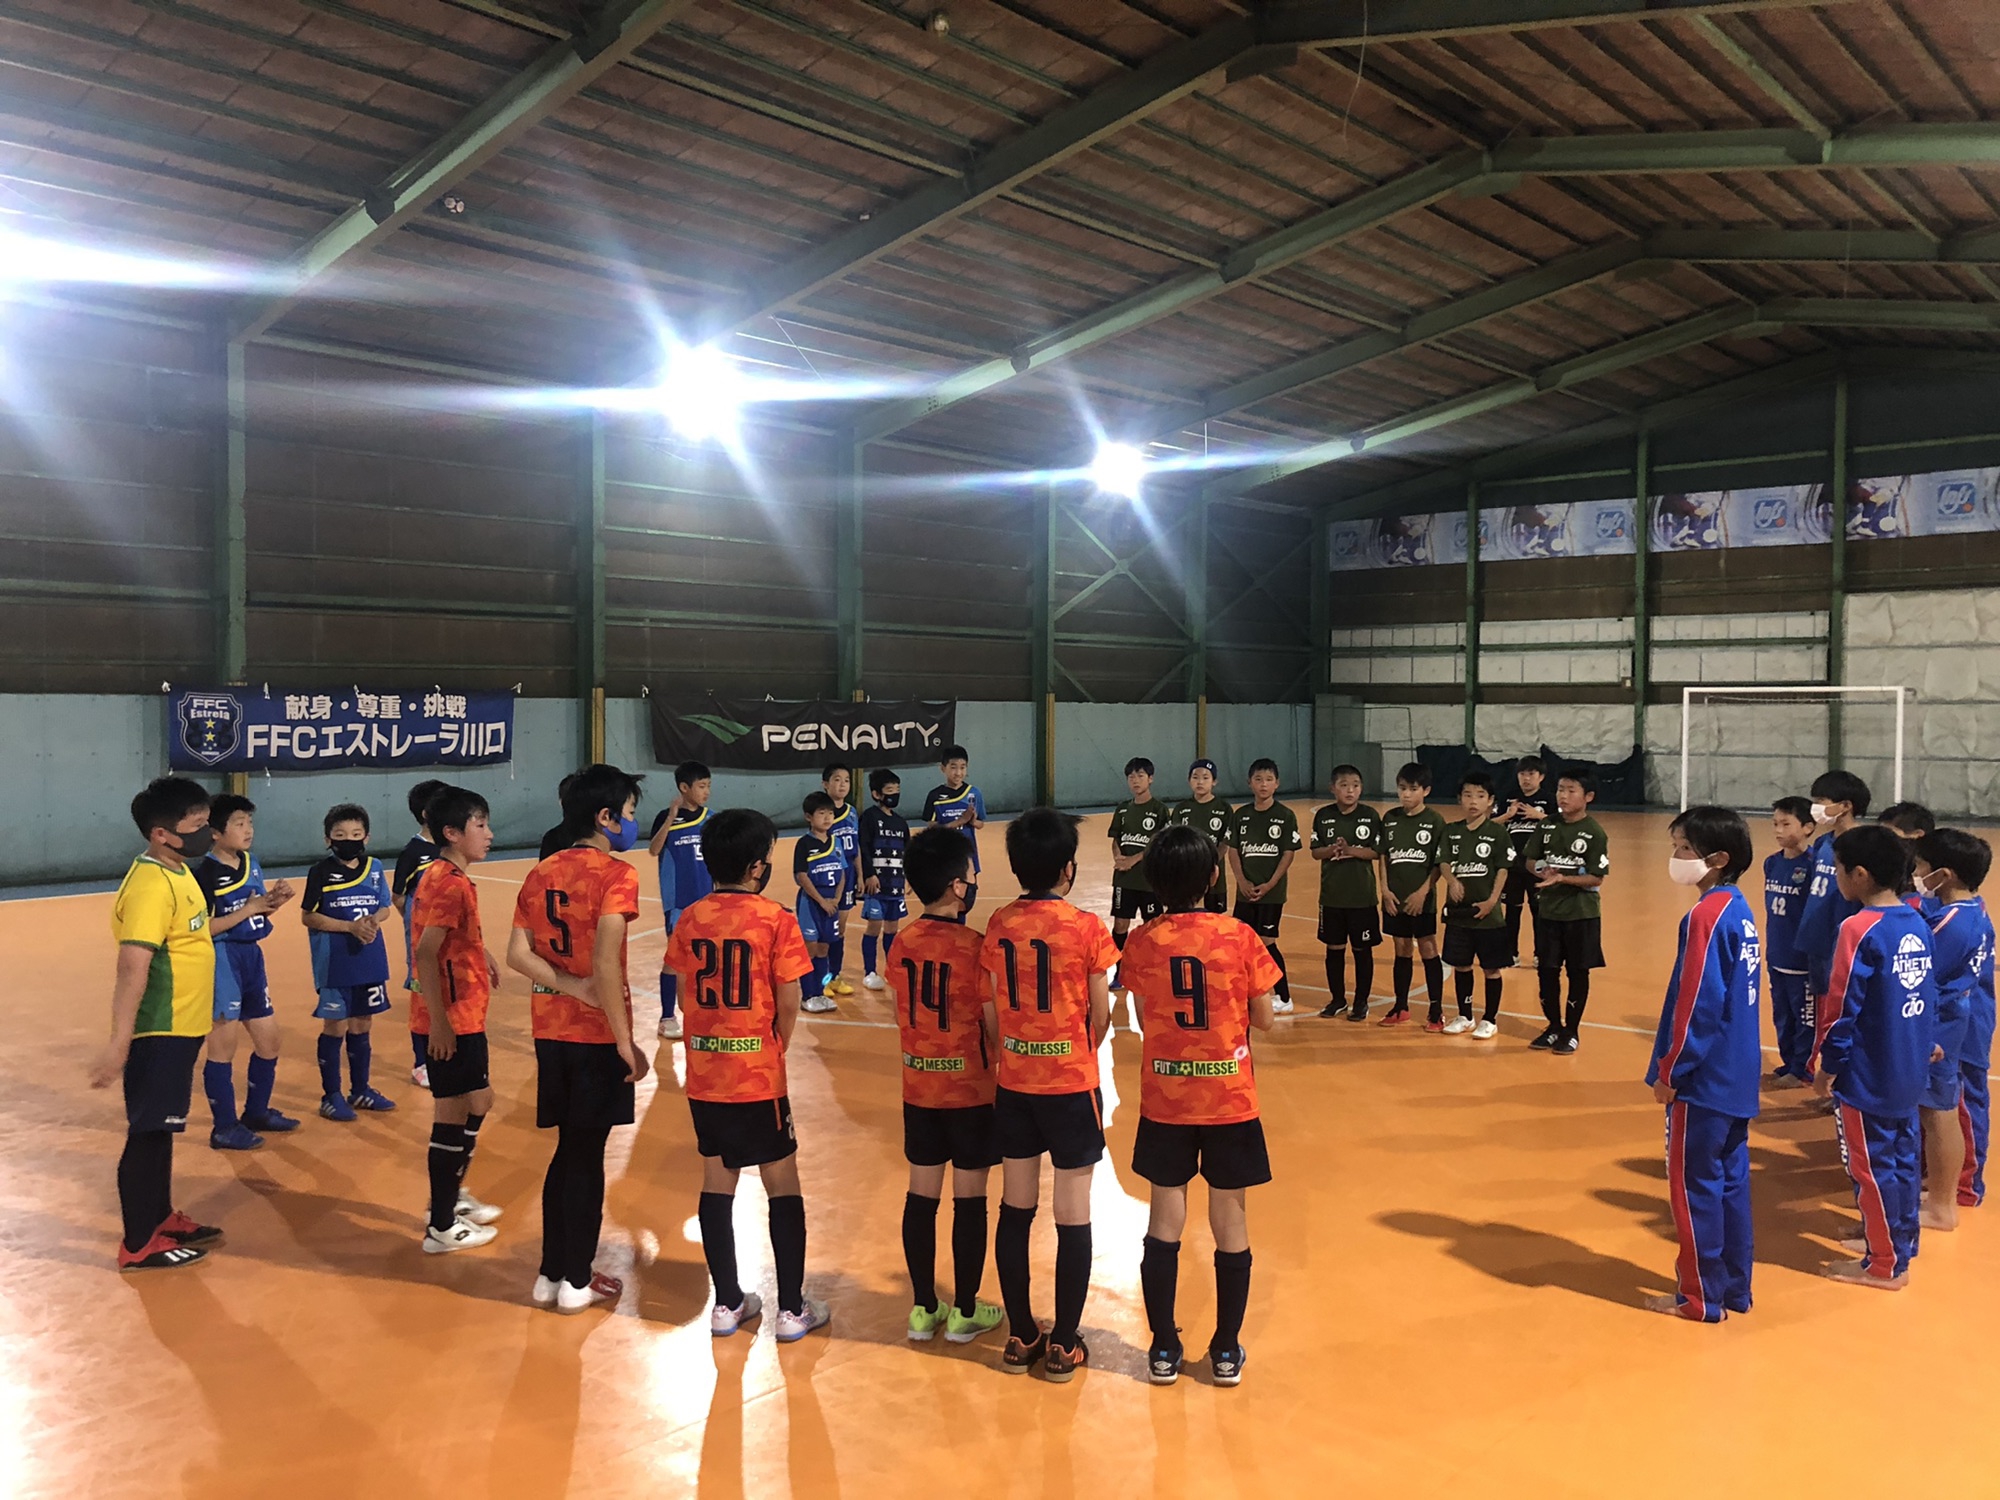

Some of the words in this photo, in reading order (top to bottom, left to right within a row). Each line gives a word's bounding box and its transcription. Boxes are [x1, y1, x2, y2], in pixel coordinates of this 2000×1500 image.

[190, 708, 231, 721] Estrela
[193, 698, 228, 710] FFC
[285, 693, 467, 720] 献身・尊重・挑戦
[247, 721, 506, 759] FFCエストレーラ川口
[761, 721, 940, 752] PENALTY
[841, 835, 854, 851] 10
[827, 871, 836, 887] 5
[1765, 880, 1800, 896] ATHLETA
[1810, 876, 1829, 898] 43
[1771, 896, 1787, 917] 42
[545, 889, 573, 958] 5
[690, 938, 753, 1011] 20
[998, 938, 1053, 1014] 11
[901, 957, 953, 1033] 14
[1168, 955, 1210, 1031] 9
[719, 1038, 761, 1052] MESSE!
[1030, 1041, 1071, 1055] MESSE!
[925, 1059, 963, 1071] MESSE!
[1153, 1060, 1171, 1075] FUT
[1195, 1061, 1238, 1075] MESSE!
